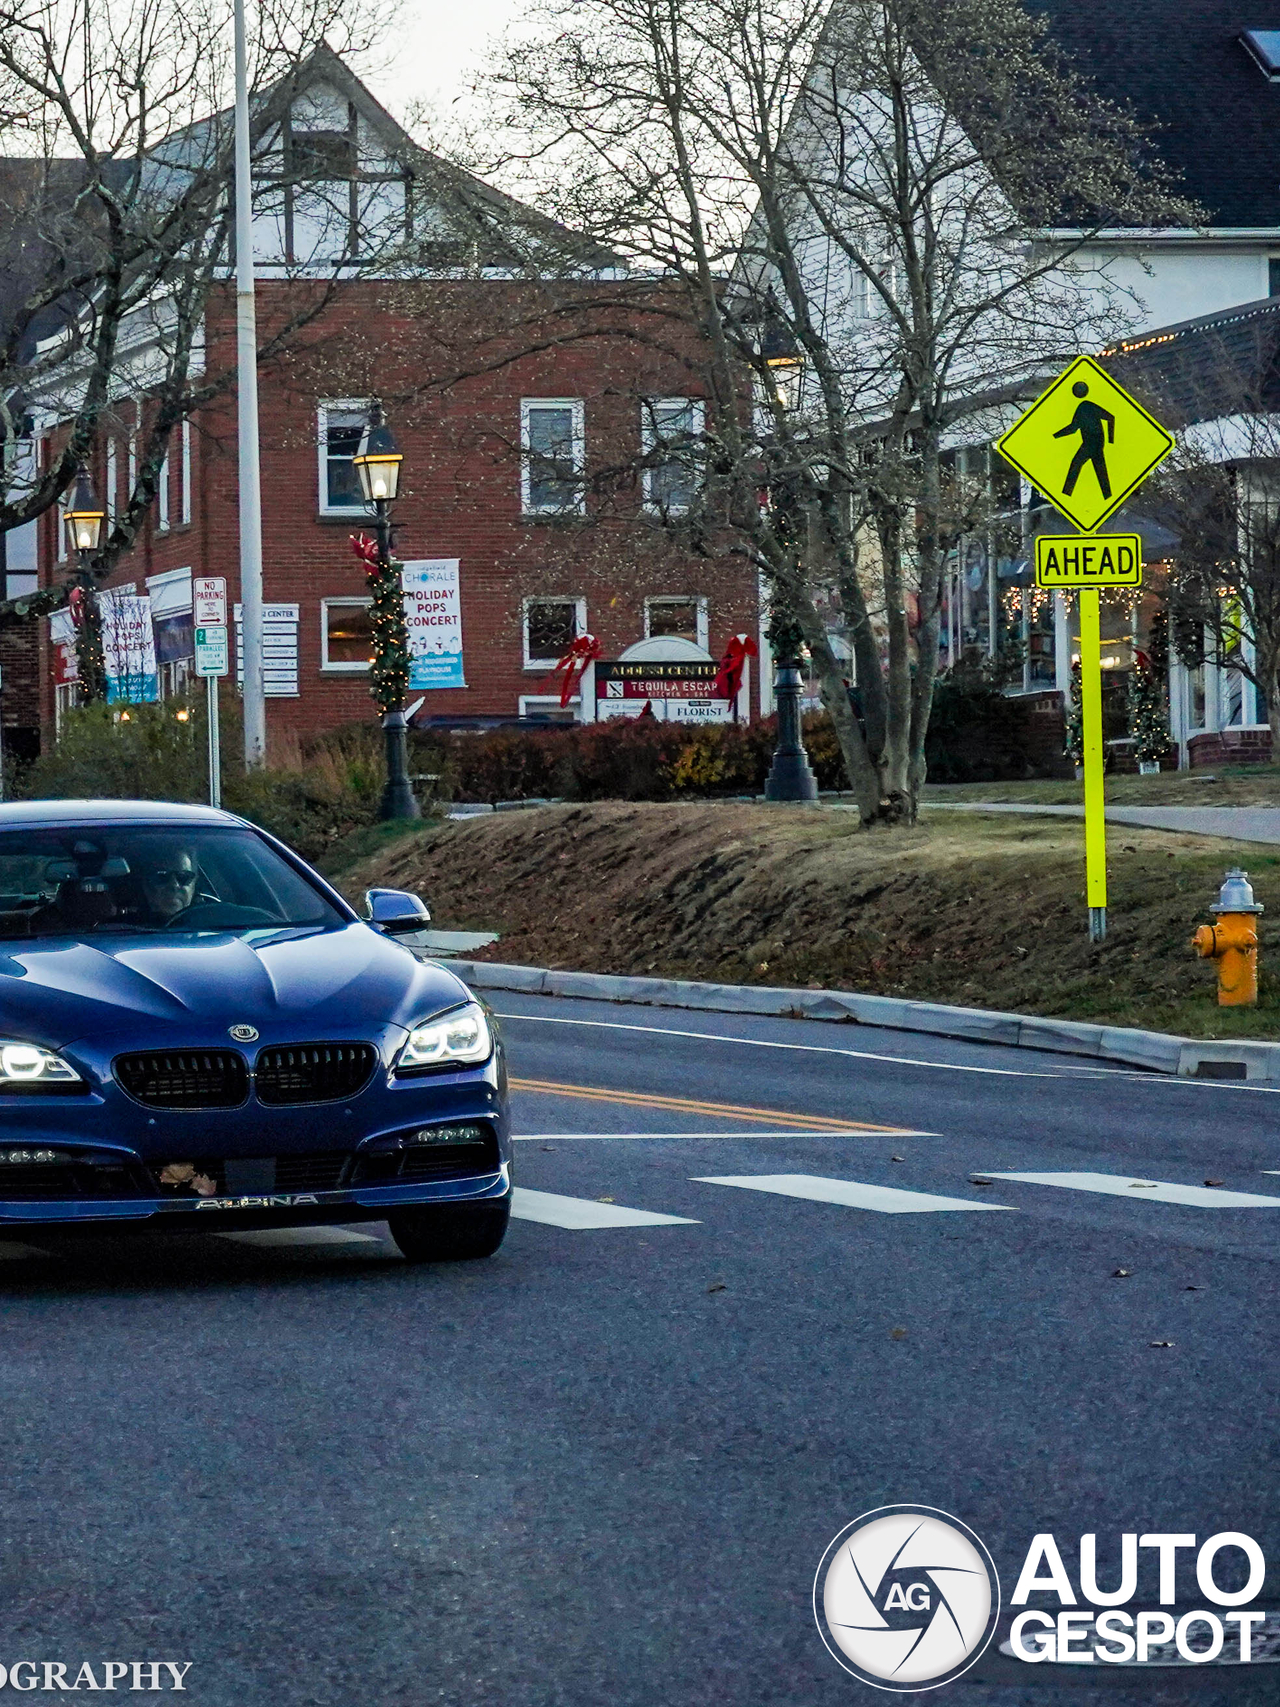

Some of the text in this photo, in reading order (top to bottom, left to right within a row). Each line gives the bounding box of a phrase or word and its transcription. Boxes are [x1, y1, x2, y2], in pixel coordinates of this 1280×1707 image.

[1044, 546, 1134, 576] AHEAD
[405, 571, 456, 583] CHORALE
[204, 581, 216, 590] NO
[196, 591, 224, 600] PARKING
[408, 589, 455, 601] HOLIDAY
[417, 603, 446, 614] POPS
[267, 610, 294, 618] CENTER
[406, 615, 458, 627] CONCERT
[198, 631, 204, 641] 2
[105, 642, 152, 652] CONCERT
[631, 681, 718, 692] TEQUILA ESCAP
[677, 707, 722, 717] FLORIST
